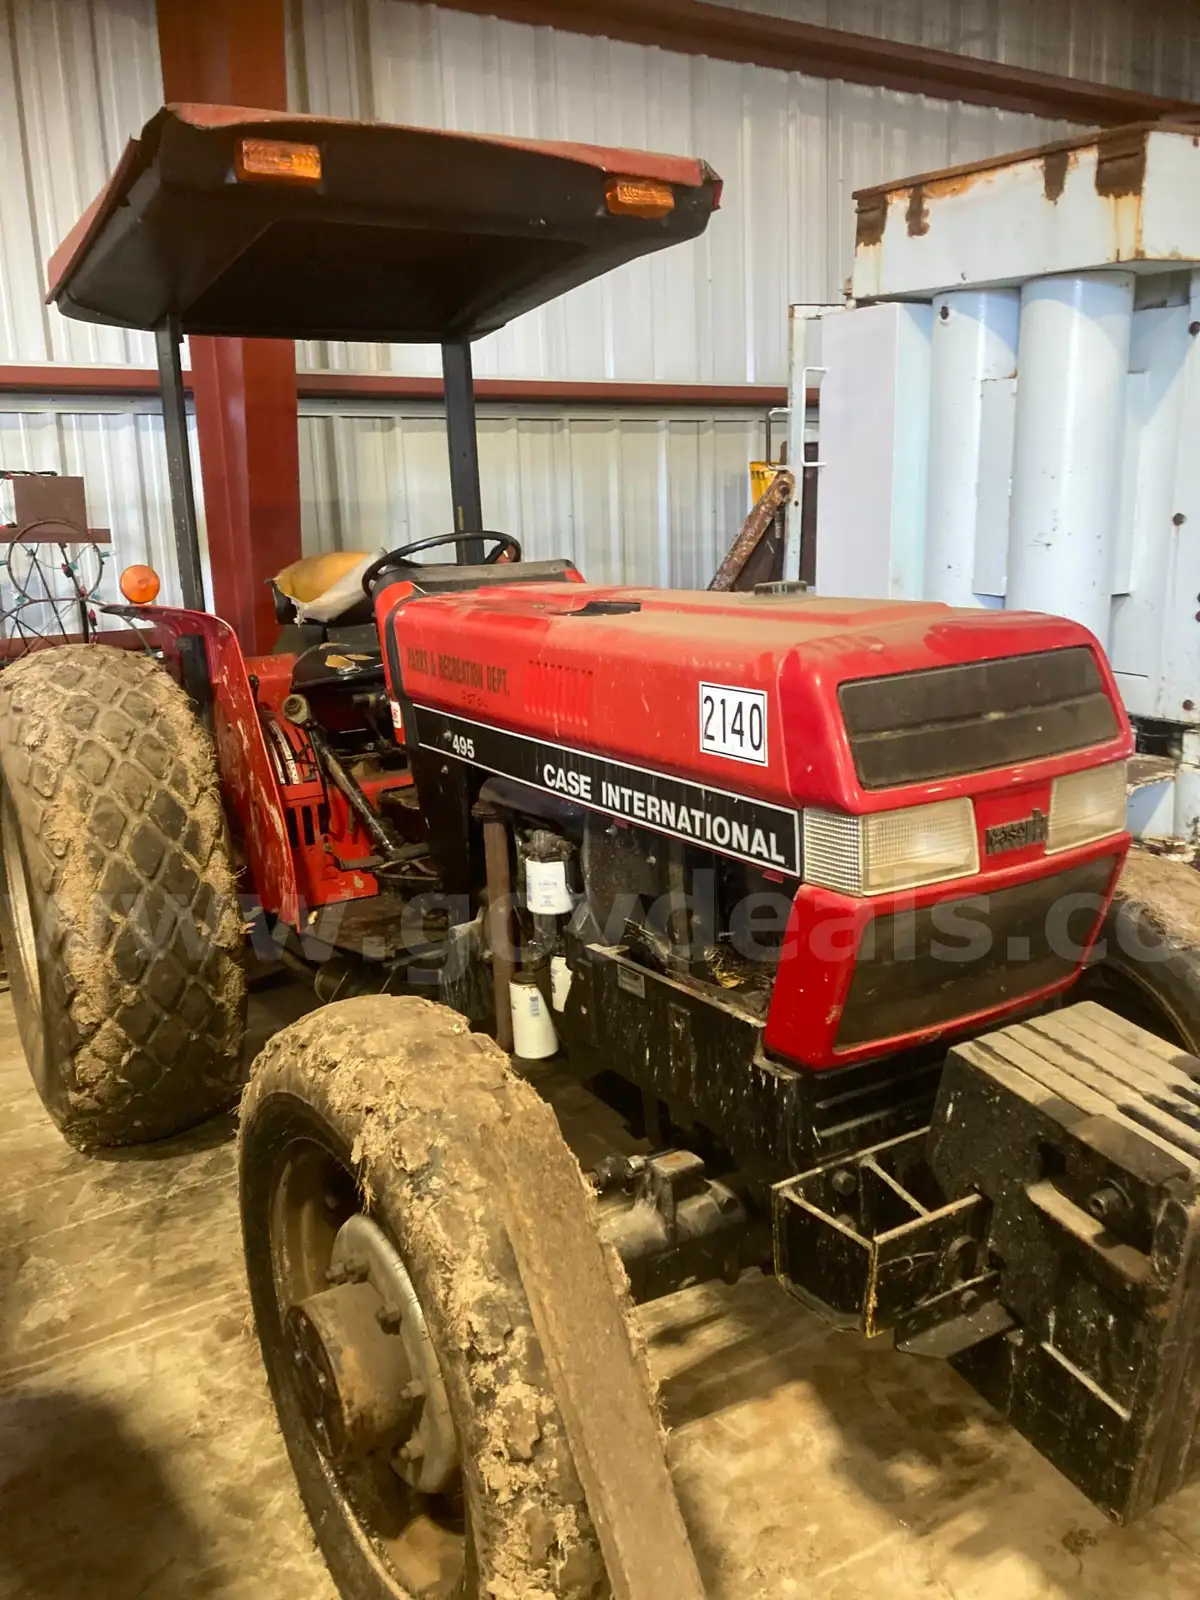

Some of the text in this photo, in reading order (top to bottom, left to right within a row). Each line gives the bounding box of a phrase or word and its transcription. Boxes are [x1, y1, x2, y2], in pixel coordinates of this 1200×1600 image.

[406, 647, 428, 675] PARKS
[438, 654, 484, 690] RECREATION
[452, 734, 475, 759] 495
[703, 695, 763, 752] 2140
[543, 764, 786, 864] CASE INTERNATIONAL
